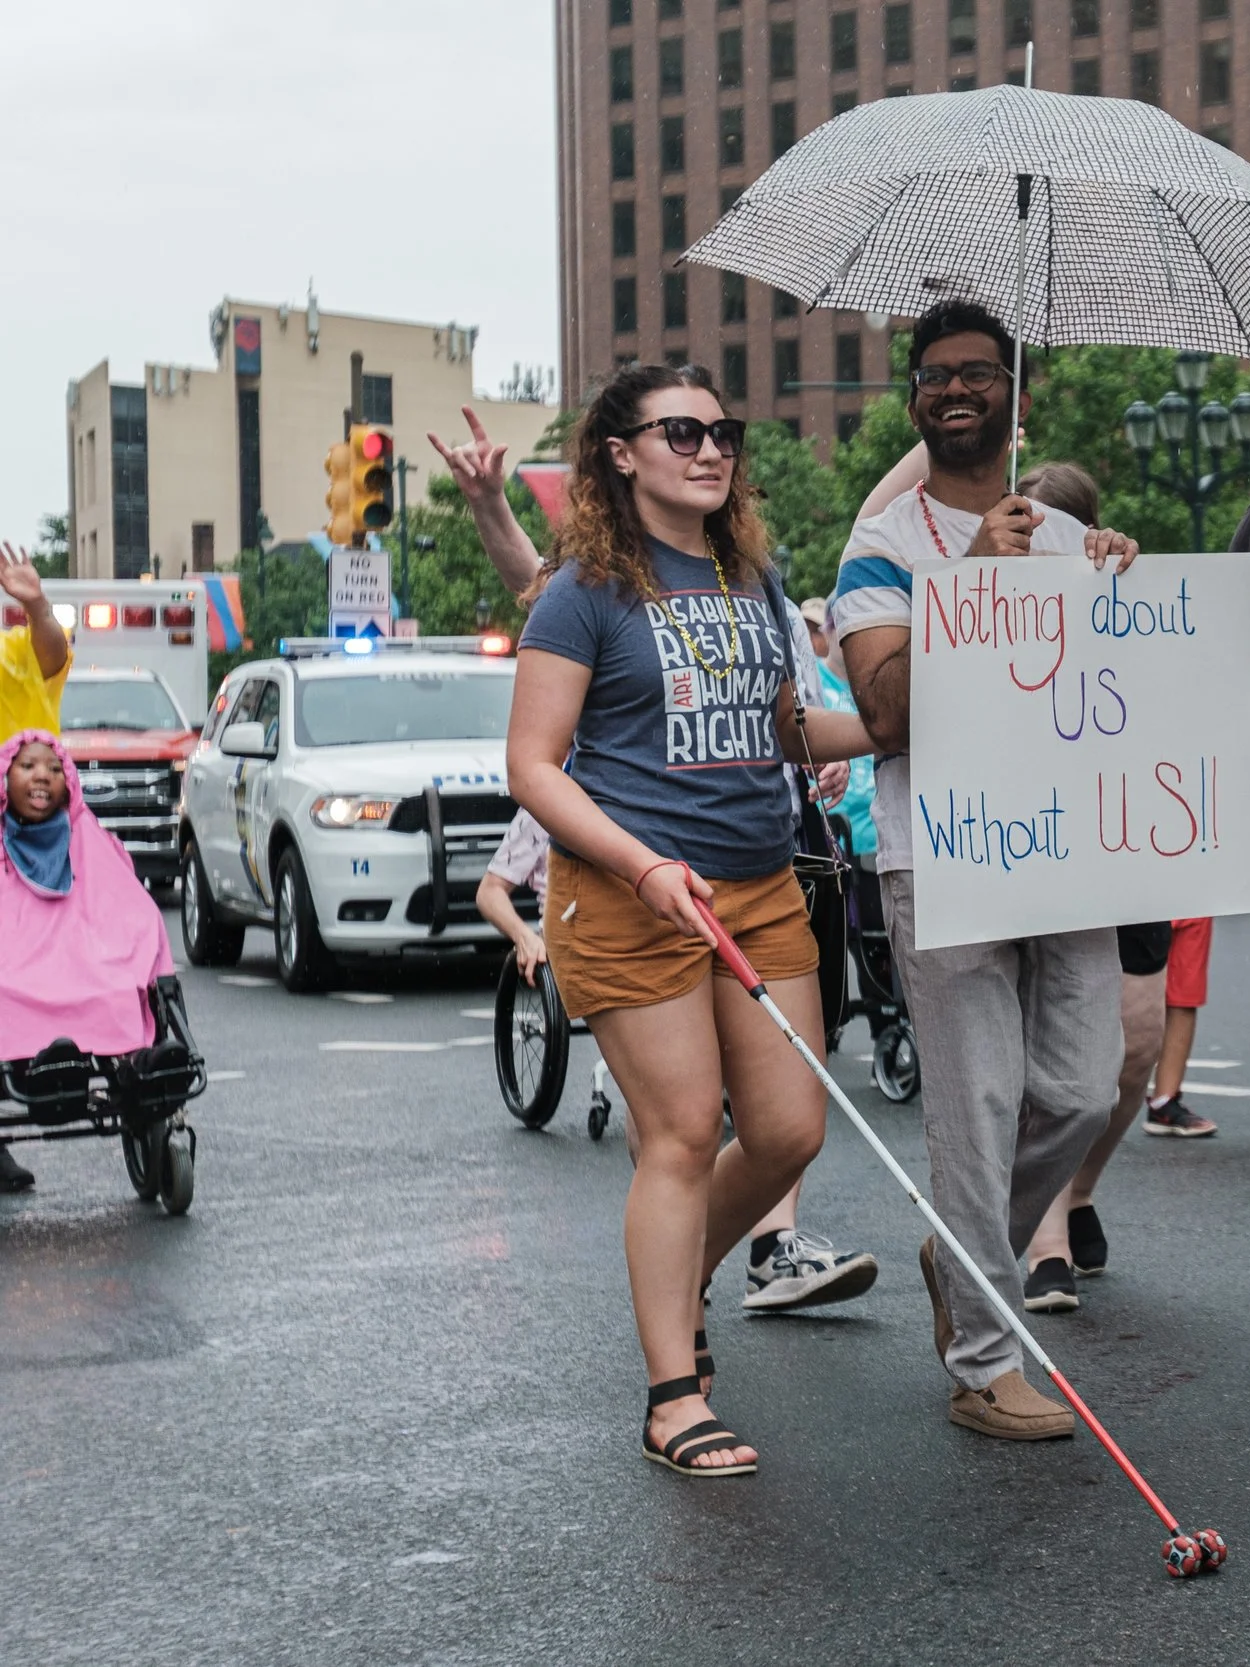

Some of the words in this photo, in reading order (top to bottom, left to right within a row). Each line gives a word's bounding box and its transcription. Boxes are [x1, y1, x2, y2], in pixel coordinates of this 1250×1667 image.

[345, 574, 378, 586] TURN
[350, 556, 371, 570] NO
[335, 590, 353, 602] ON
[360, 590, 385, 603] RED
[644, 596, 770, 629] DISABILITY
[924, 567, 1065, 691] Nothing
[1091, 573, 1196, 638] about
[673, 671, 693, 708] ARE
[699, 669, 782, 706] HUMAN
[667, 710, 774, 763] RIGHTS
[919, 787, 1069, 872] Without
[352, 858, 370, 876] T4
